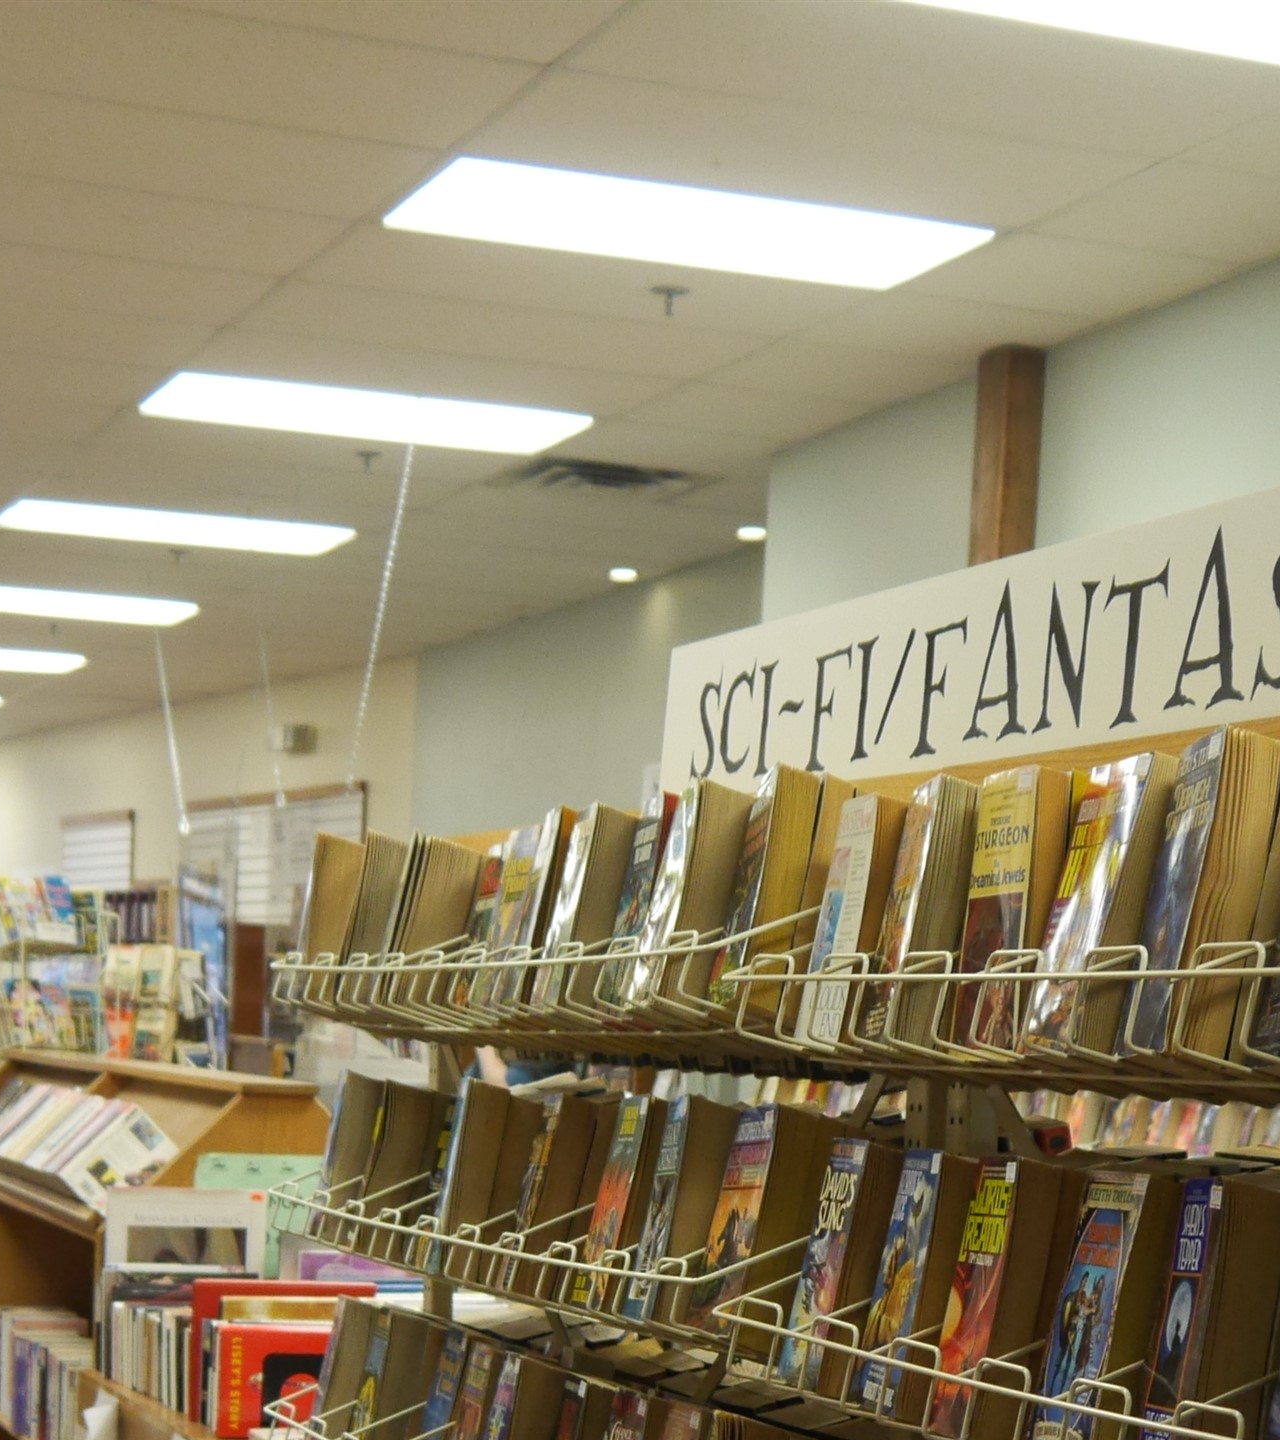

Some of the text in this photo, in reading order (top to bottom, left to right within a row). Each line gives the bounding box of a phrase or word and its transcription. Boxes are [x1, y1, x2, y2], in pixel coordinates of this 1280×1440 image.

[975, 824, 1030, 852] STURGEON
[819, 1165, 859, 1207] DAVID'S
[814, 1202, 846, 1237] SLING
